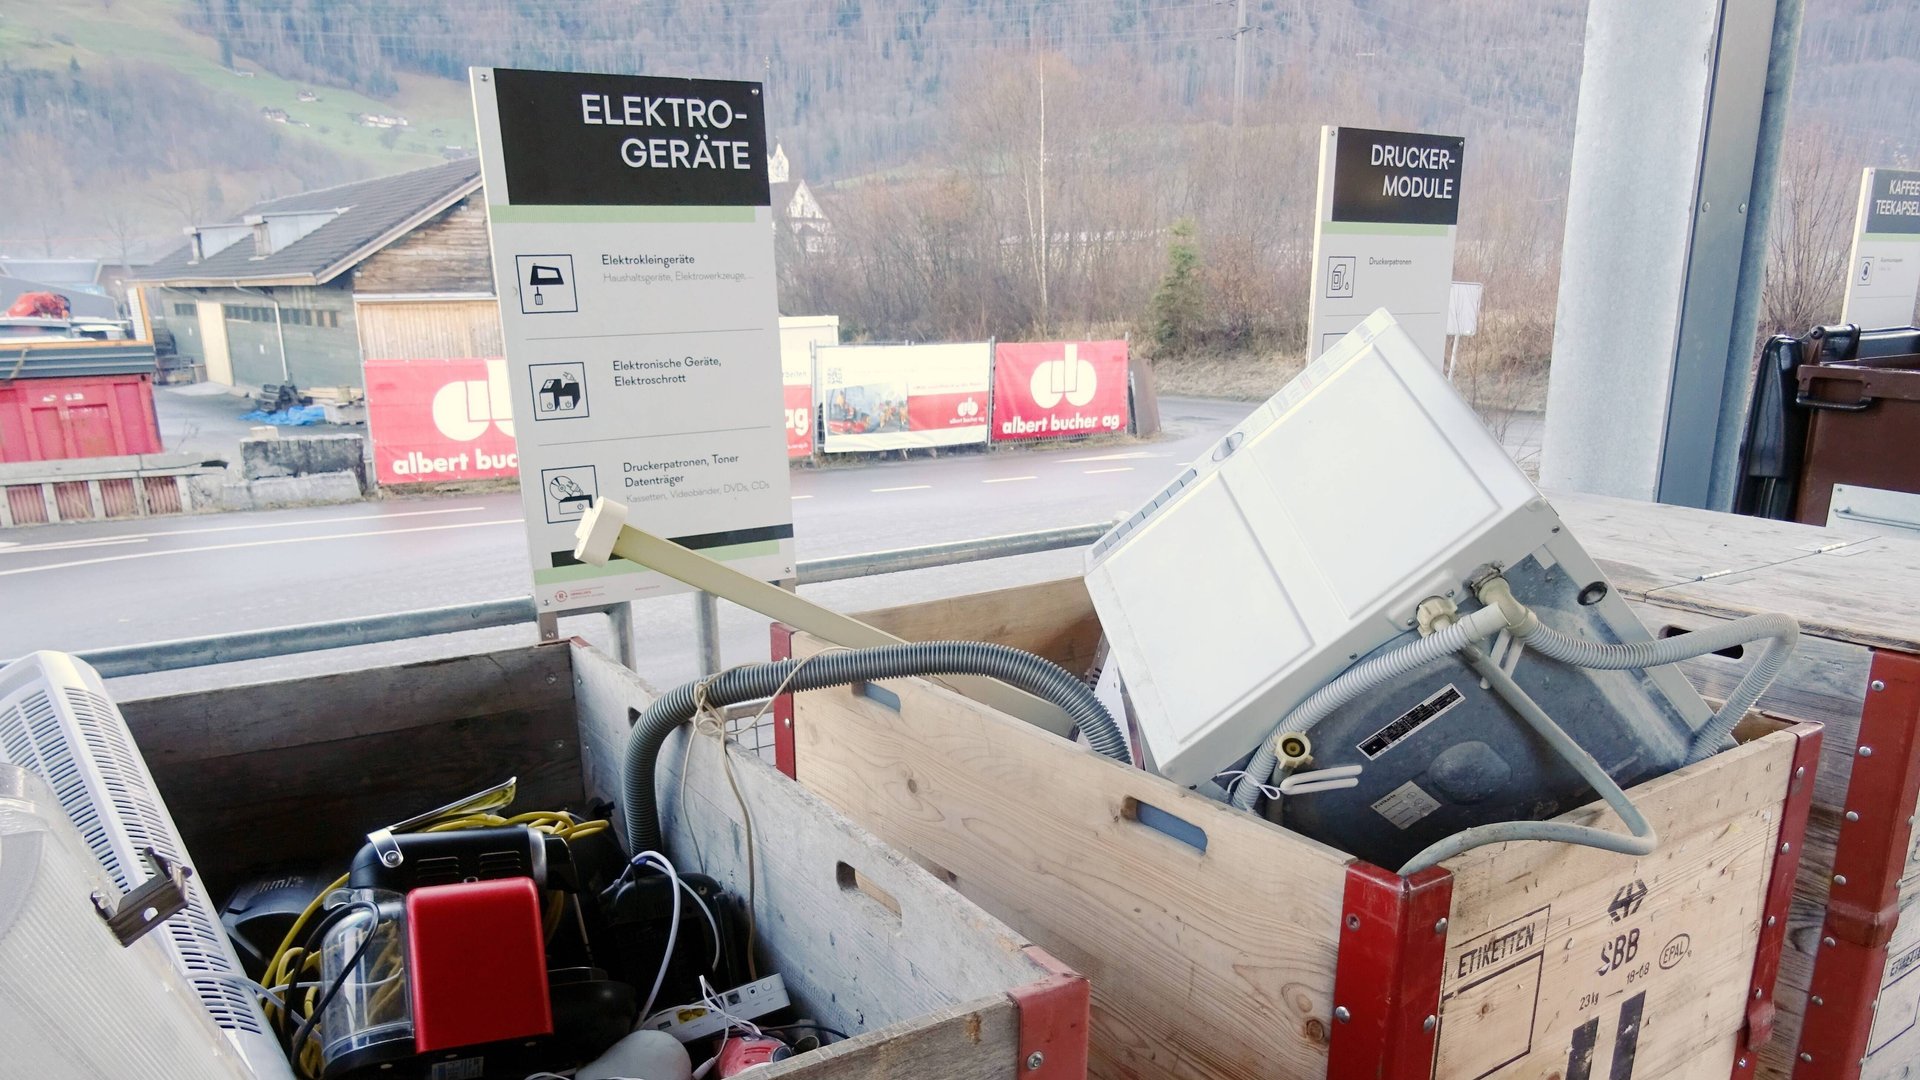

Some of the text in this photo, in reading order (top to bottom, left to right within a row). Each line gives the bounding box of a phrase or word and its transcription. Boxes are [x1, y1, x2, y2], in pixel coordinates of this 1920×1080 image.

[581, 93, 748, 129] ELEKTRO-
[620, 133, 751, 170] GERÄTE
[1370, 144, 1456, 170] DRUCKER-
[1382, 175, 1454, 199] MODULE
[1888, 179, 1920, 196] KAFFEE
[1875, 199, 1920, 216] TEEKAPSEL
[601, 253, 695, 269] Elektrokleingeräte
[1368, 256, 1412, 266] Druckerpatronen
[603, 271, 673, 285] Haushaltsgeräte,
[612, 356, 722, 371] Elektronische Geräte,
[614, 374, 687, 387] Elektroschrott
[1002, 412, 1119, 434] albert bucher ag
[392, 448, 518, 475] albert buc
[623, 454, 739, 473] Druckerpatronen, Toner
[625, 475, 684, 487] Datenträger
[751, 480, 770, 490] CDs
[1458, 923, 1534, 979] ETIKETTEN
[1598, 928, 1640, 977] SBB
[1663, 940, 1684, 965] EPAL
